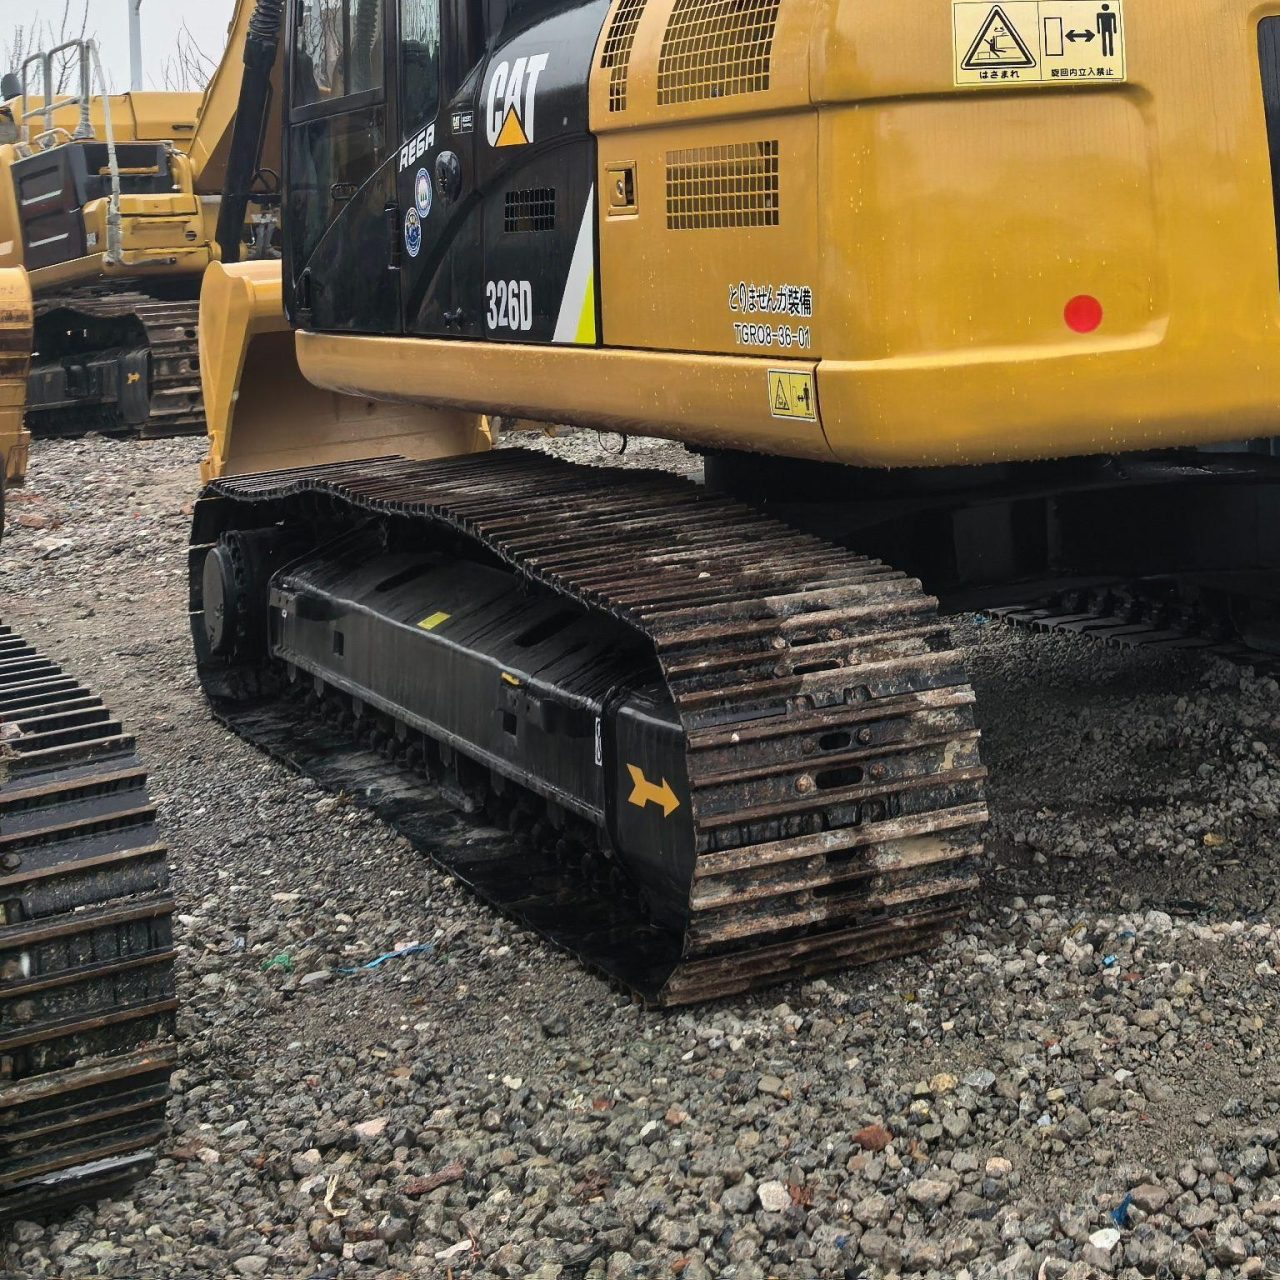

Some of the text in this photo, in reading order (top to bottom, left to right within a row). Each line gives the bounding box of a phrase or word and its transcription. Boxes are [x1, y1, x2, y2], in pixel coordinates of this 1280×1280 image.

[487, 53, 550, 148] CAT
[979, 70, 1021, 80] はさまれ
[486, 280, 533, 332] 326D
